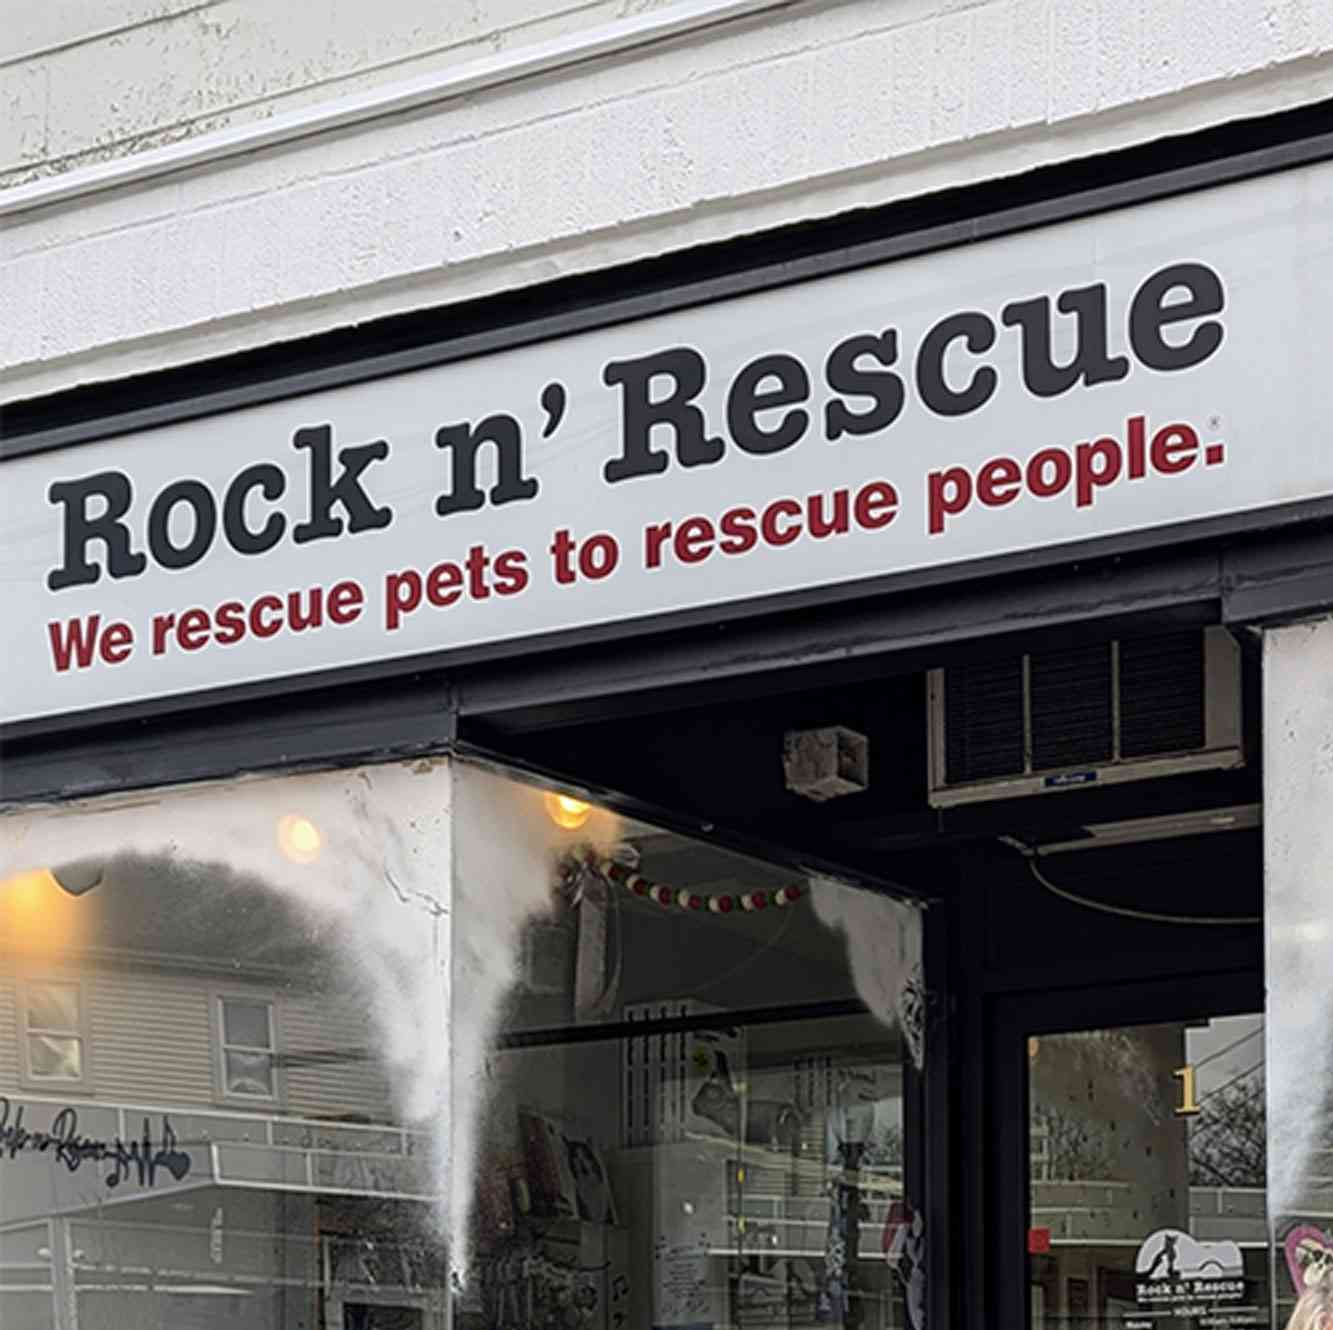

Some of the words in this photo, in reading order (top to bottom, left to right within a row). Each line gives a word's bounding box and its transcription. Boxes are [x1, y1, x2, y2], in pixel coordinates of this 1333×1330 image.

[48, 425, 392, 591] Rock
[436, 383, 566, 516] n'
[603, 263, 1225, 483] Rescue
[51, 618, 132, 672] We
[153, 581, 363, 654] rescue
[386, 547, 528, 630] pets
[552, 531, 618, 583] to
[645, 482, 897, 568] rescue
[928, 416, 1223, 535] people.
[1173, 1065, 1200, 1114] 1
[1136, 1282, 1171, 1296] Rock
[1193, 1280, 1245, 1293] Rescue
